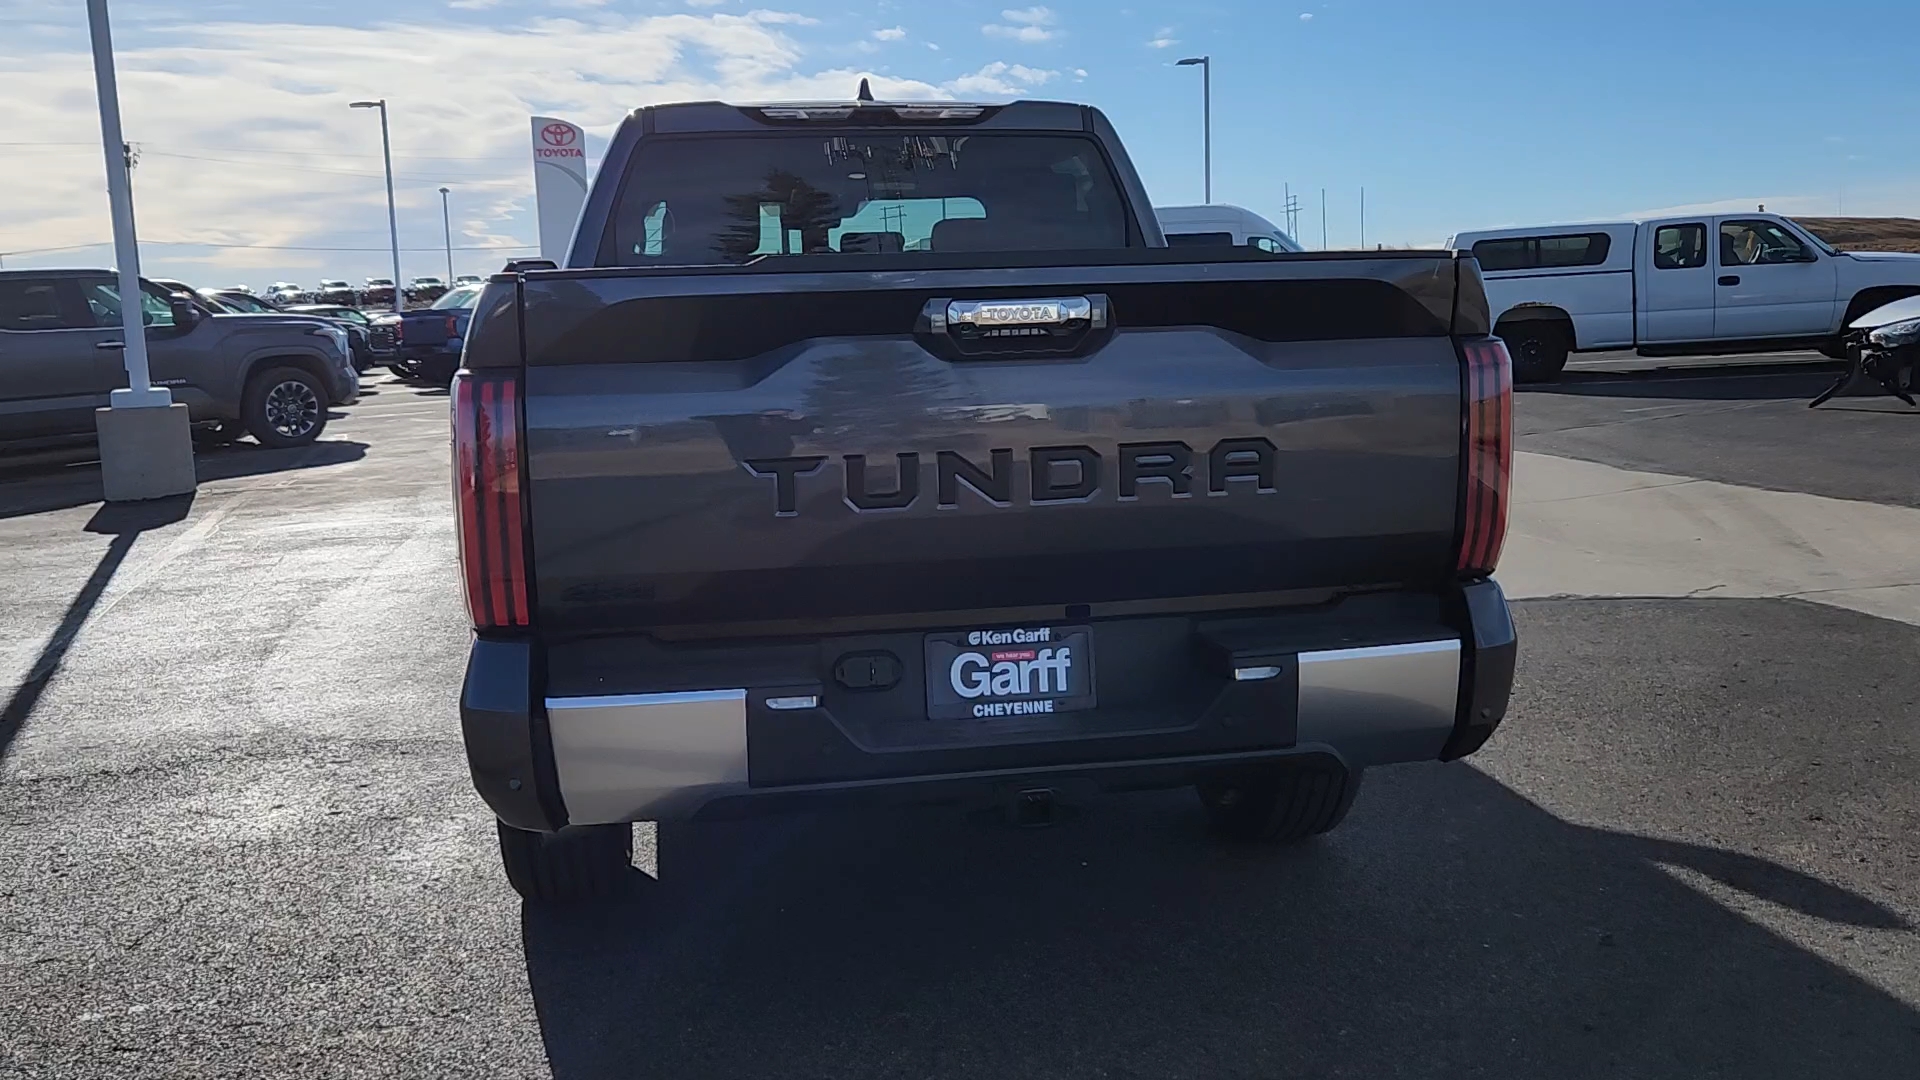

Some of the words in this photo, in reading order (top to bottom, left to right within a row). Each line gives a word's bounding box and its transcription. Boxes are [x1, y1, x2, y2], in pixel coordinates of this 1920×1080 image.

[535, 148, 585, 158] TOYOTA
[987, 306, 1052, 321] TOYOTA
[741, 436, 1278, 518] TUNDRA
[981, 630, 1012, 646] Ken
[1013, 627, 1051, 643] Garff
[950, 647, 1072, 699] Garff
[972, 699, 1054, 718] CHEYENNE
